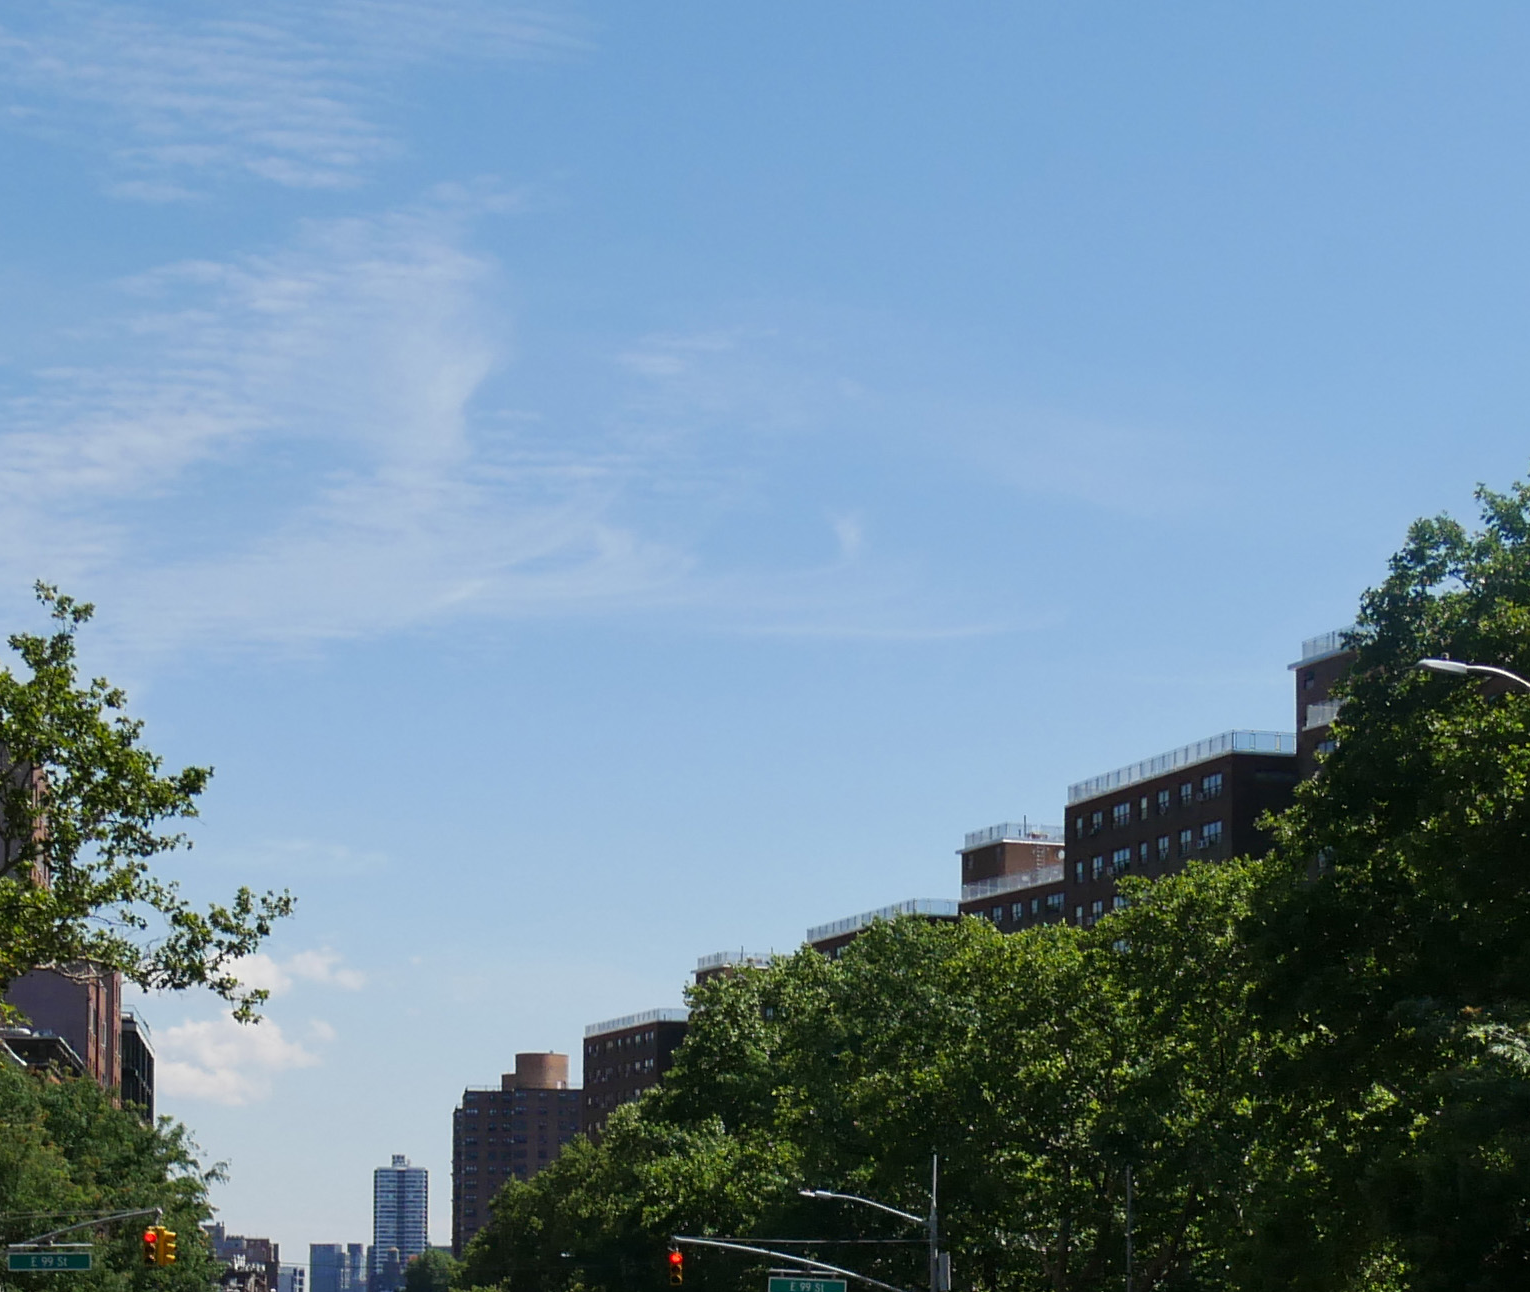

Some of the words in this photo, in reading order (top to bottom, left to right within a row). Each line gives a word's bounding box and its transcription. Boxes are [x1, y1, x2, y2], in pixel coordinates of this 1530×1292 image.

[30, 1256, 37, 1267] E
[41, 1256, 54, 1267] 99
[57, 1256, 68, 1267] St
[790, 1282, 796, 1292] E
[799, 1283, 811, 1292] 99
[813, 1283, 824, 1292] St
